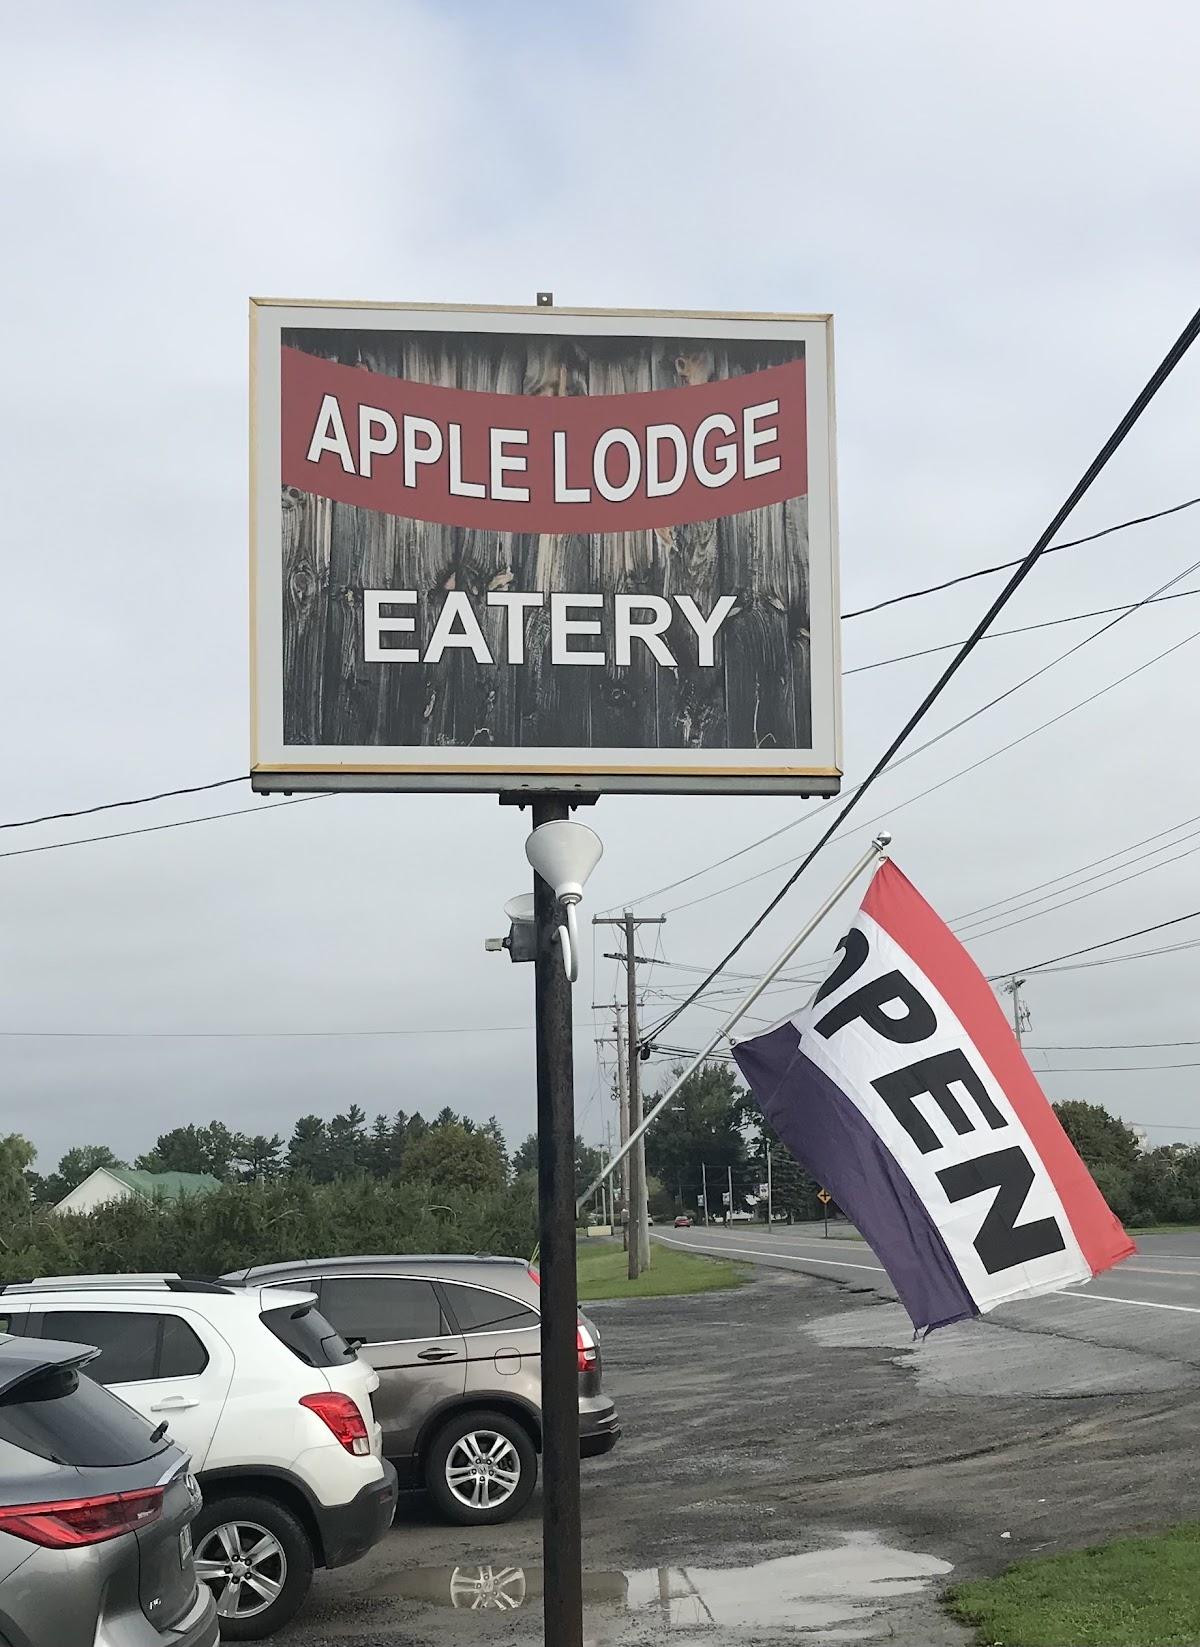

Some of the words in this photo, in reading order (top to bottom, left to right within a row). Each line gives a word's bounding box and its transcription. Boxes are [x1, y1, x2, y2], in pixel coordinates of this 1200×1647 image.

[306, 393, 531, 503] APPLE
[553, 398, 782, 504] LODGE
[363, 588, 737, 668] EATERY
